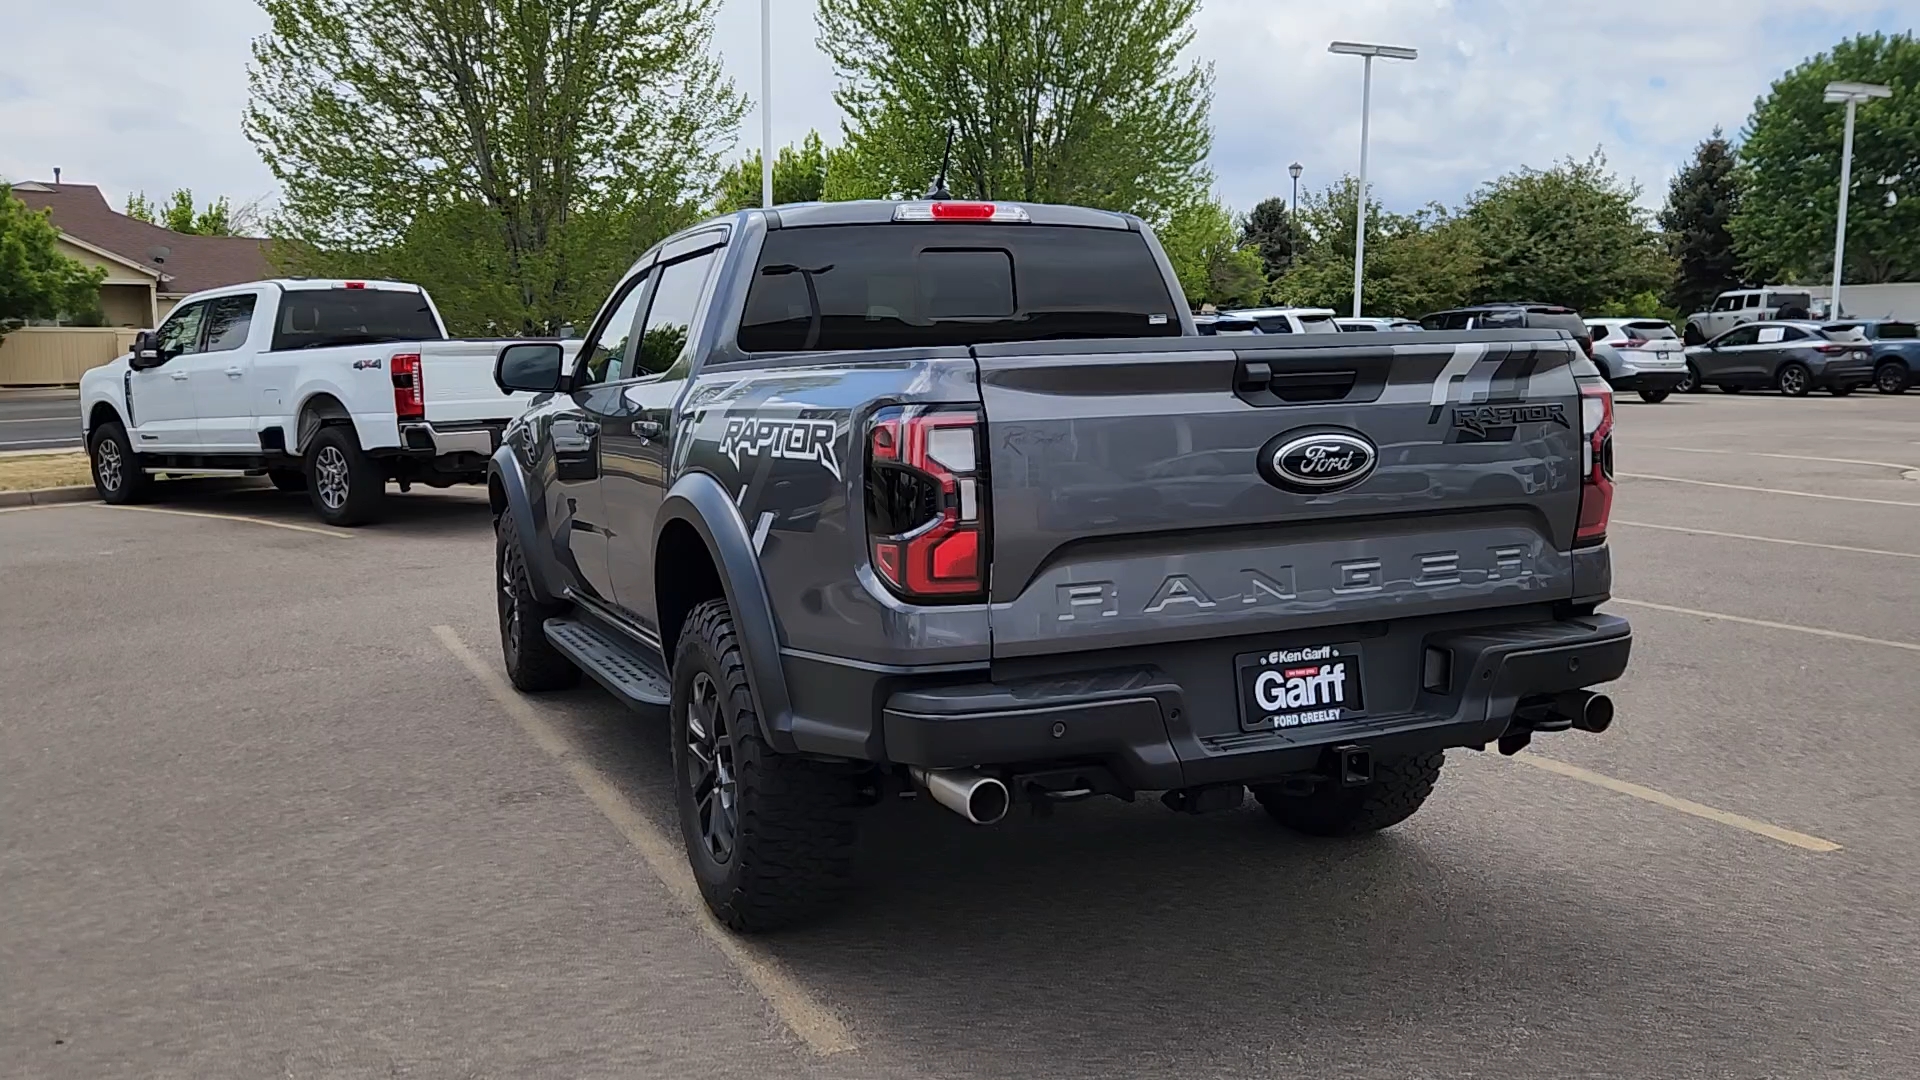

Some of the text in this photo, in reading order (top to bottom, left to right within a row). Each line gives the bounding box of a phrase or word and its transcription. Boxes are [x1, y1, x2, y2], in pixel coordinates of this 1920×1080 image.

[1452, 402, 1571, 438] RAPTOR
[718, 417, 842, 482] RAPTOR
[1300, 446, 1354, 473] Ford
[1056, 543, 1535, 620] RANGER
[1280, 646, 1331, 663] Ken Garff
[1255, 663, 1346, 711] Garff
[1274, 709, 1340, 728] FORD GREELEY
